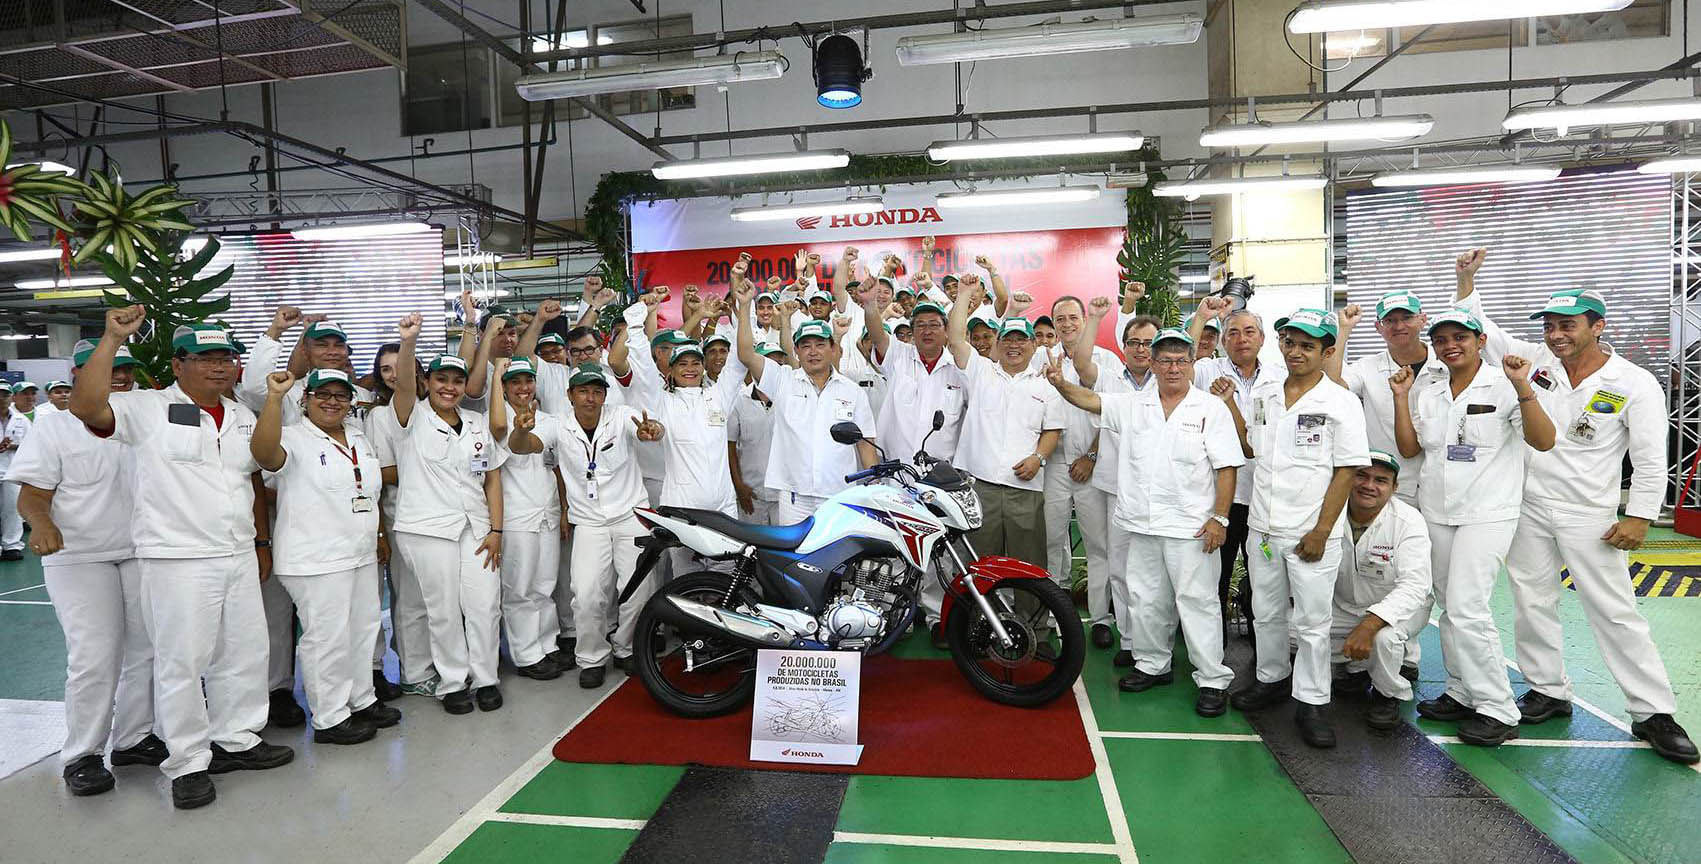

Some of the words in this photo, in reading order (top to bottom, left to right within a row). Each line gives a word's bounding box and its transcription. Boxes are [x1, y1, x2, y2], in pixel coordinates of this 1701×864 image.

[830, 207, 943, 228] HONDA
[706, 255, 812, 285] 200000
[780, 656, 836, 669] 20.000.000
[777, 668, 785, 676] DE
[788, 669, 838, 678] MOTOCICLETAS
[767, 676, 809, 685] PRODUZIDAS
[811, 678, 820, 686] NO
[791, 750, 824, 758] HONDA
